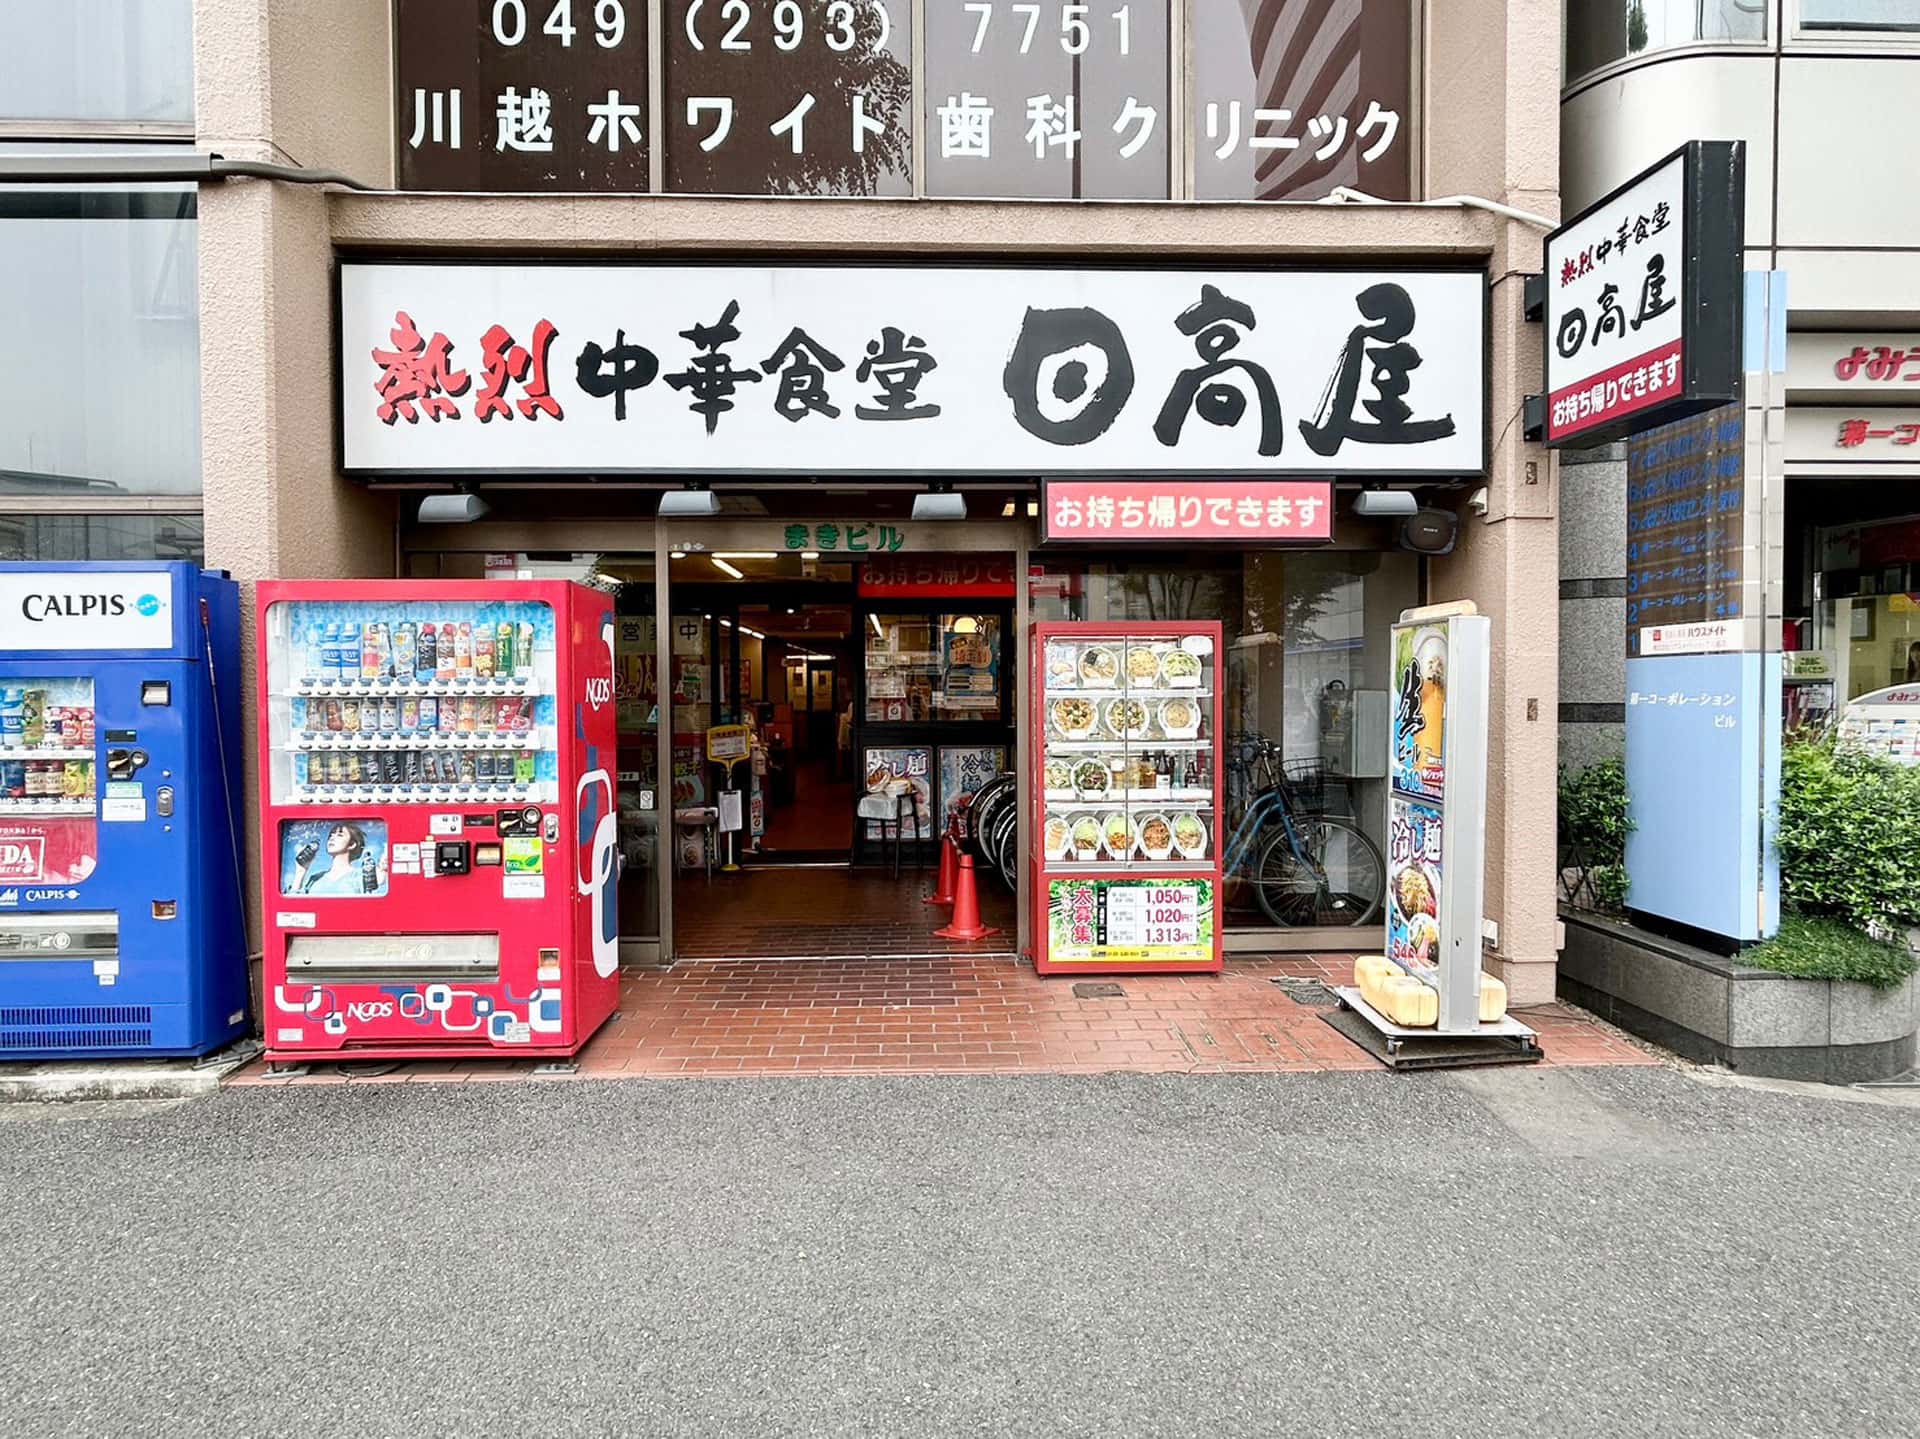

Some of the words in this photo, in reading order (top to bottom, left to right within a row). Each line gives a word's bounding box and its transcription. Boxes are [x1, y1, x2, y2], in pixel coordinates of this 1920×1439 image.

[492, 0, 625, 48] 049
[968, 2, 1132, 57] 7751
[1560, 201, 1671, 288] 熱烈中華食堂
[1555, 253, 1677, 359] 日高屋
[372, 300, 942, 437] 熱烈中華食堂
[1003, 283, 1456, 457] 日高屋
[1551, 353, 1682, 427] お持ち帰りできます
[1054, 494, 1324, 530] お持ち帰りできます
[784, 522, 905, 551] まきビル
[1628, 573, 1639, 593] 3
[22, 593, 125, 622] CALPIS
[1628, 603, 1639, 624] 2
[25, 889, 66, 902] CALPIS
